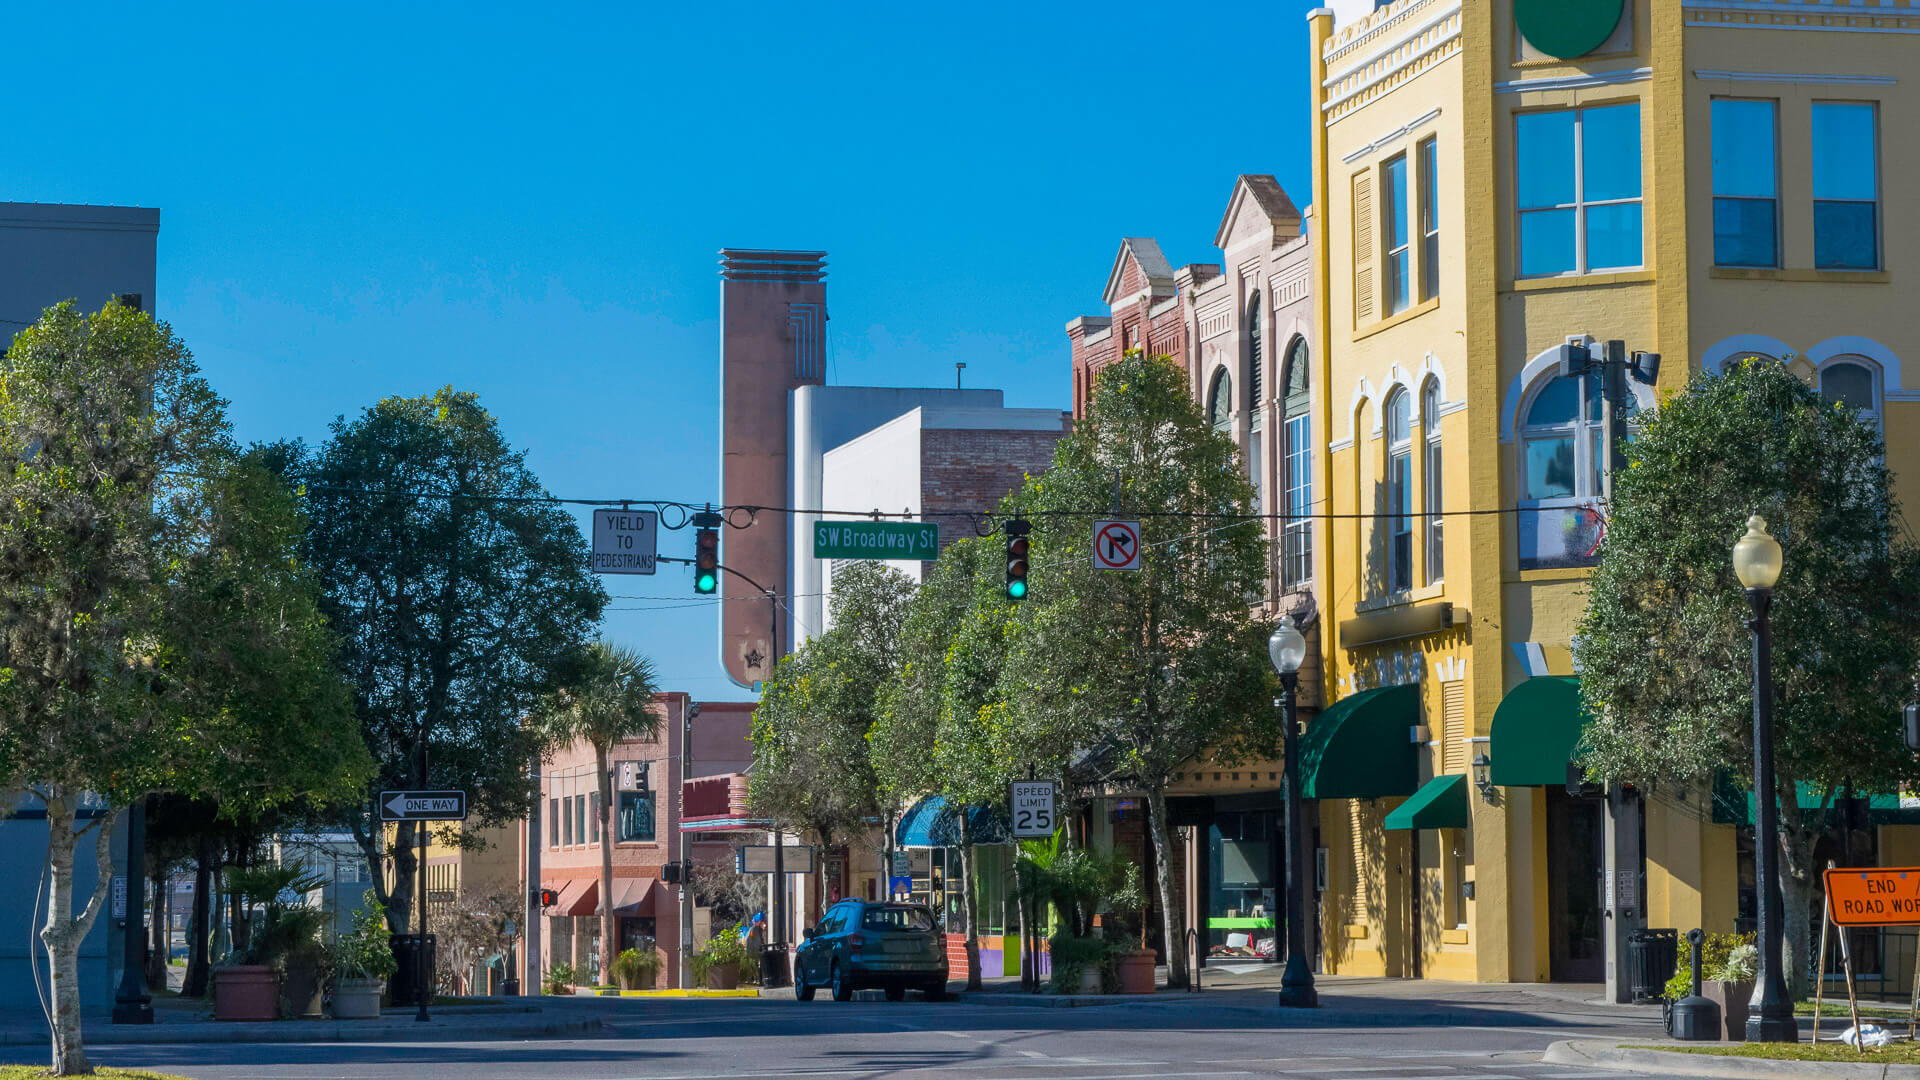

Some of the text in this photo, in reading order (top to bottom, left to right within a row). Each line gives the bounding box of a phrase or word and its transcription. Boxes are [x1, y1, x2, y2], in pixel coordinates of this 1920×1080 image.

[607, 516, 645, 531] YIELD
[616, 535, 633, 550] TO
[819, 527, 935, 554] SW Broadway St
[595, 553, 653, 569] PEDESTRIANS
[1016, 787, 1051, 797] SPEED
[406, 799, 455, 810] ONE WAY
[1020, 798, 1047, 808] LIMIT
[1017, 810, 1051, 830] 25
[1867, 879, 1896, 894] END
[1844, 898, 1920, 915] ROAD WOR
